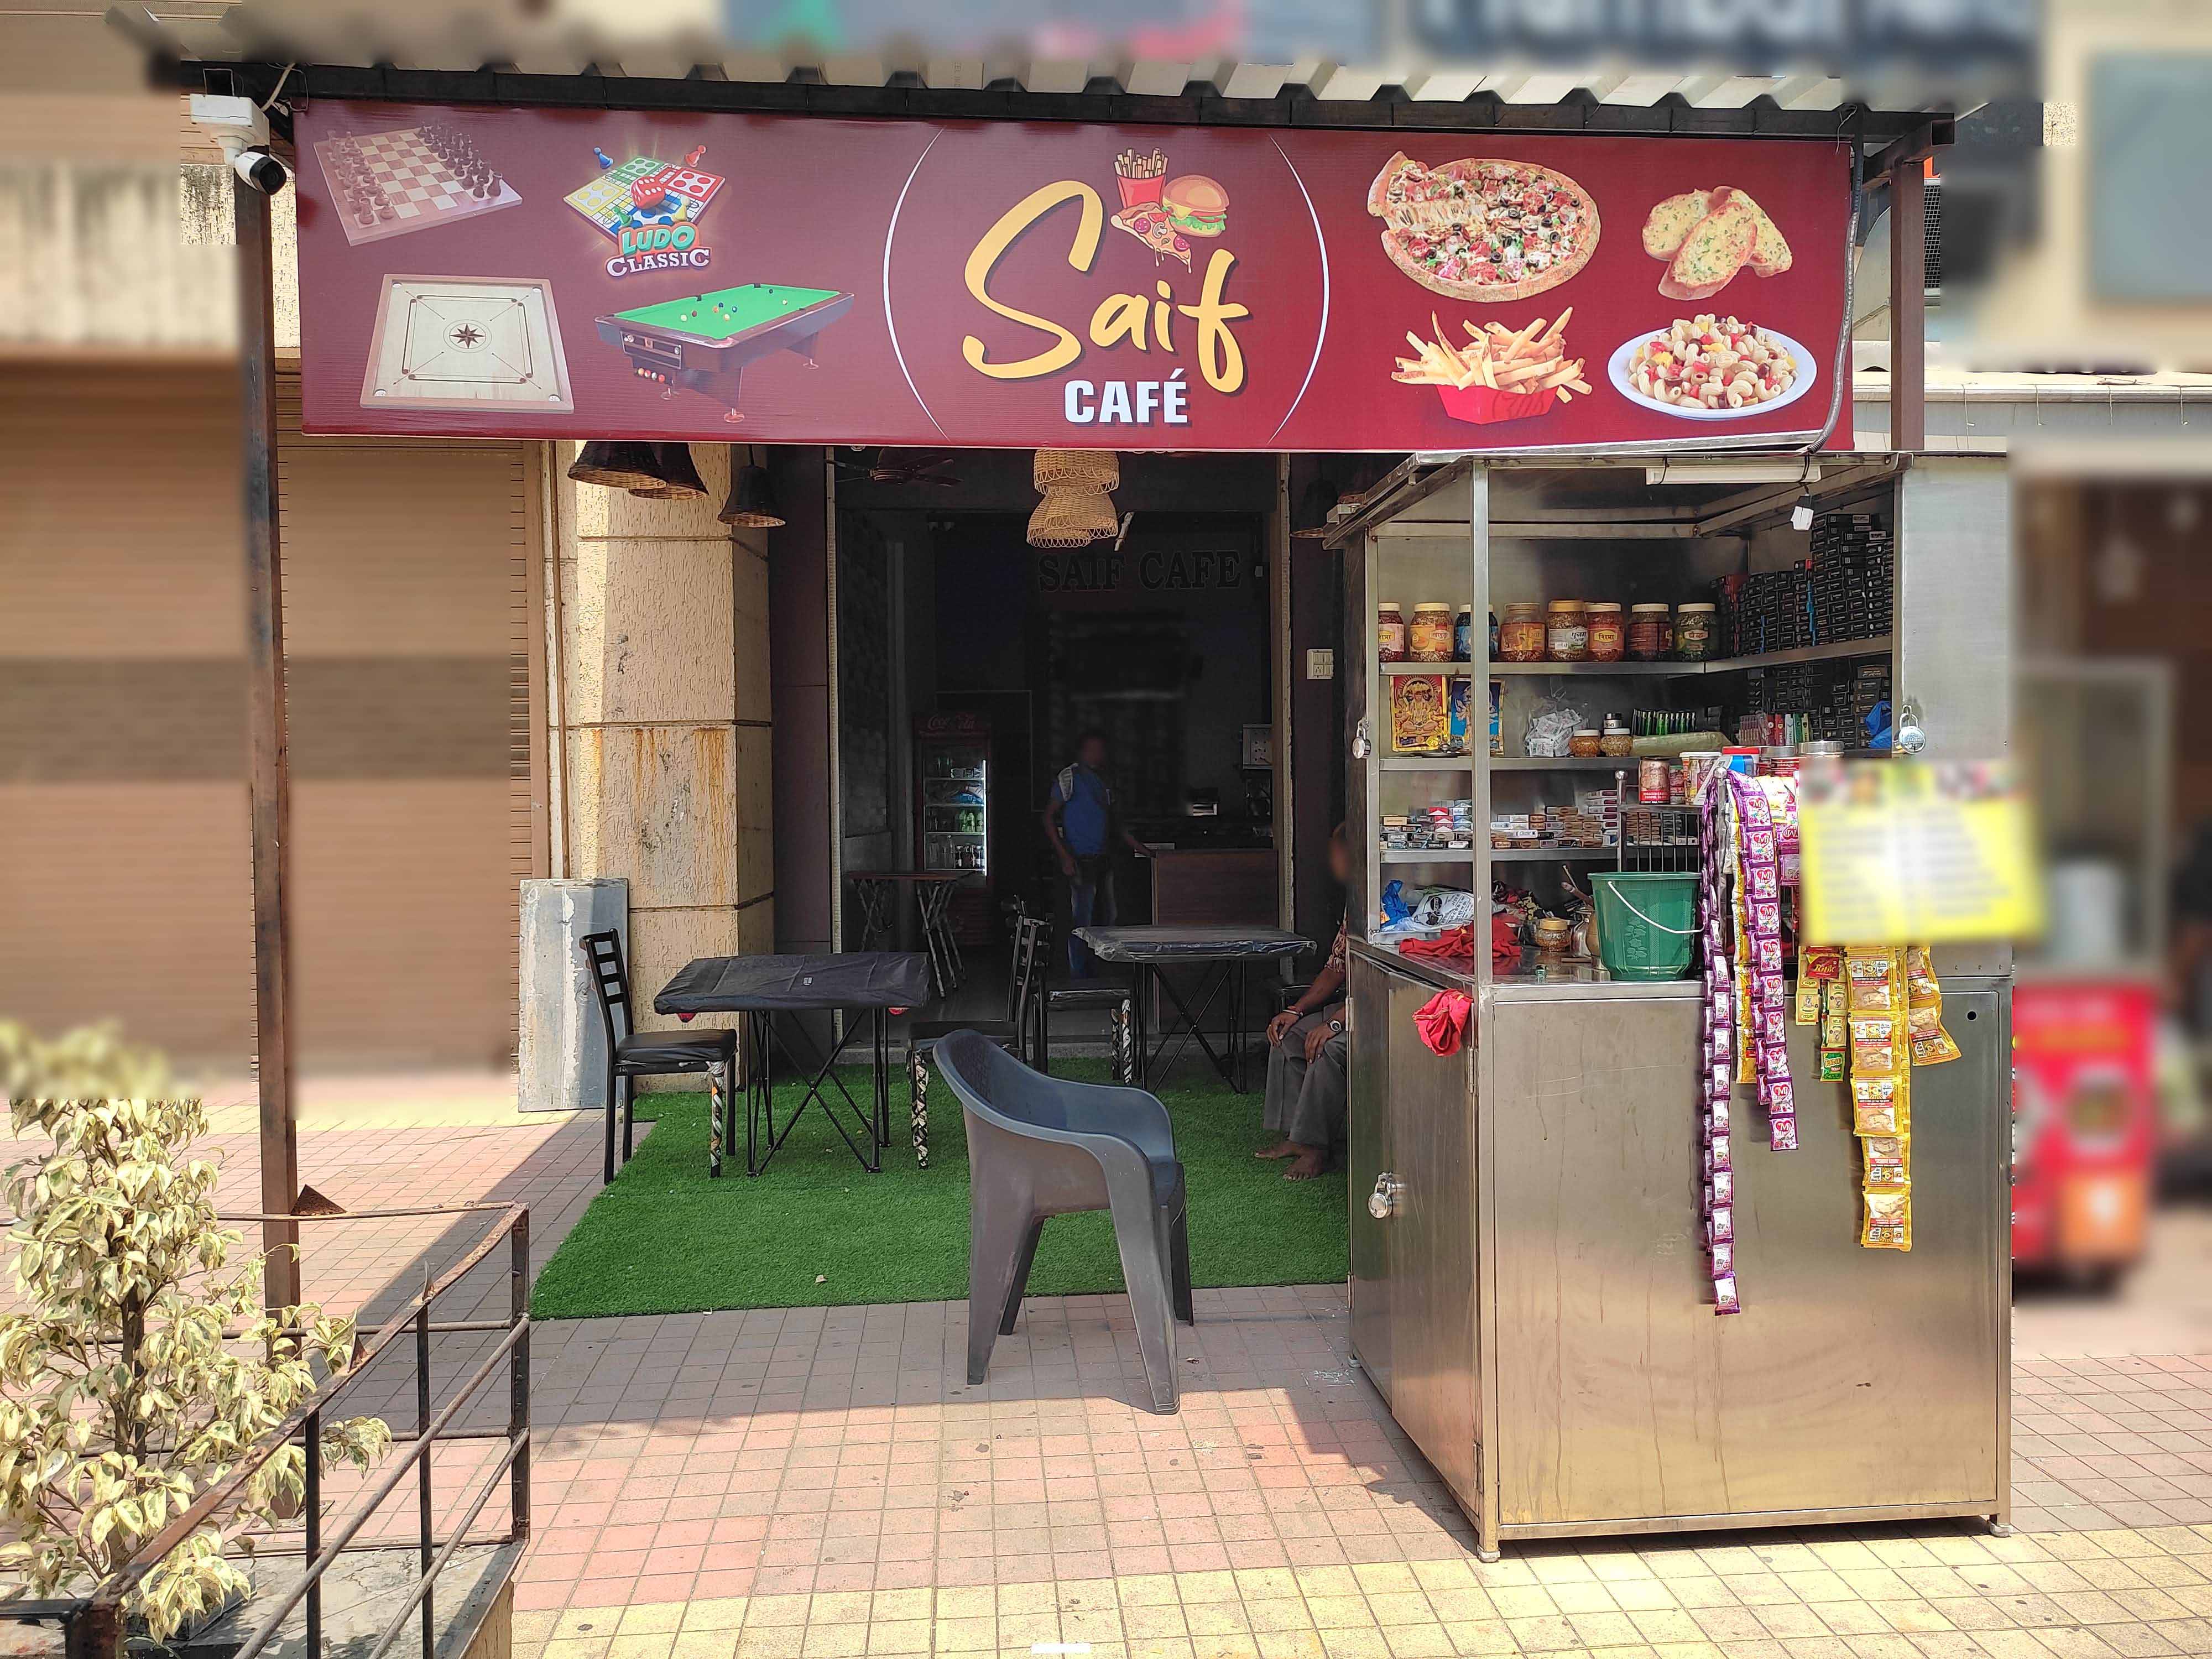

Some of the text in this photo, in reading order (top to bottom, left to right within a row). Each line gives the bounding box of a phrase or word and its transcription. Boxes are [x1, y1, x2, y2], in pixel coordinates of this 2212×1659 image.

[607, 248, 710, 276] CLASSIC
[622, 226, 696, 256] LUDO
[962, 179, 1250, 393] Saif
[1065, 368, 1189, 424] CAFÉ
[1038, 550, 1243, 592] SAIF CAFE
